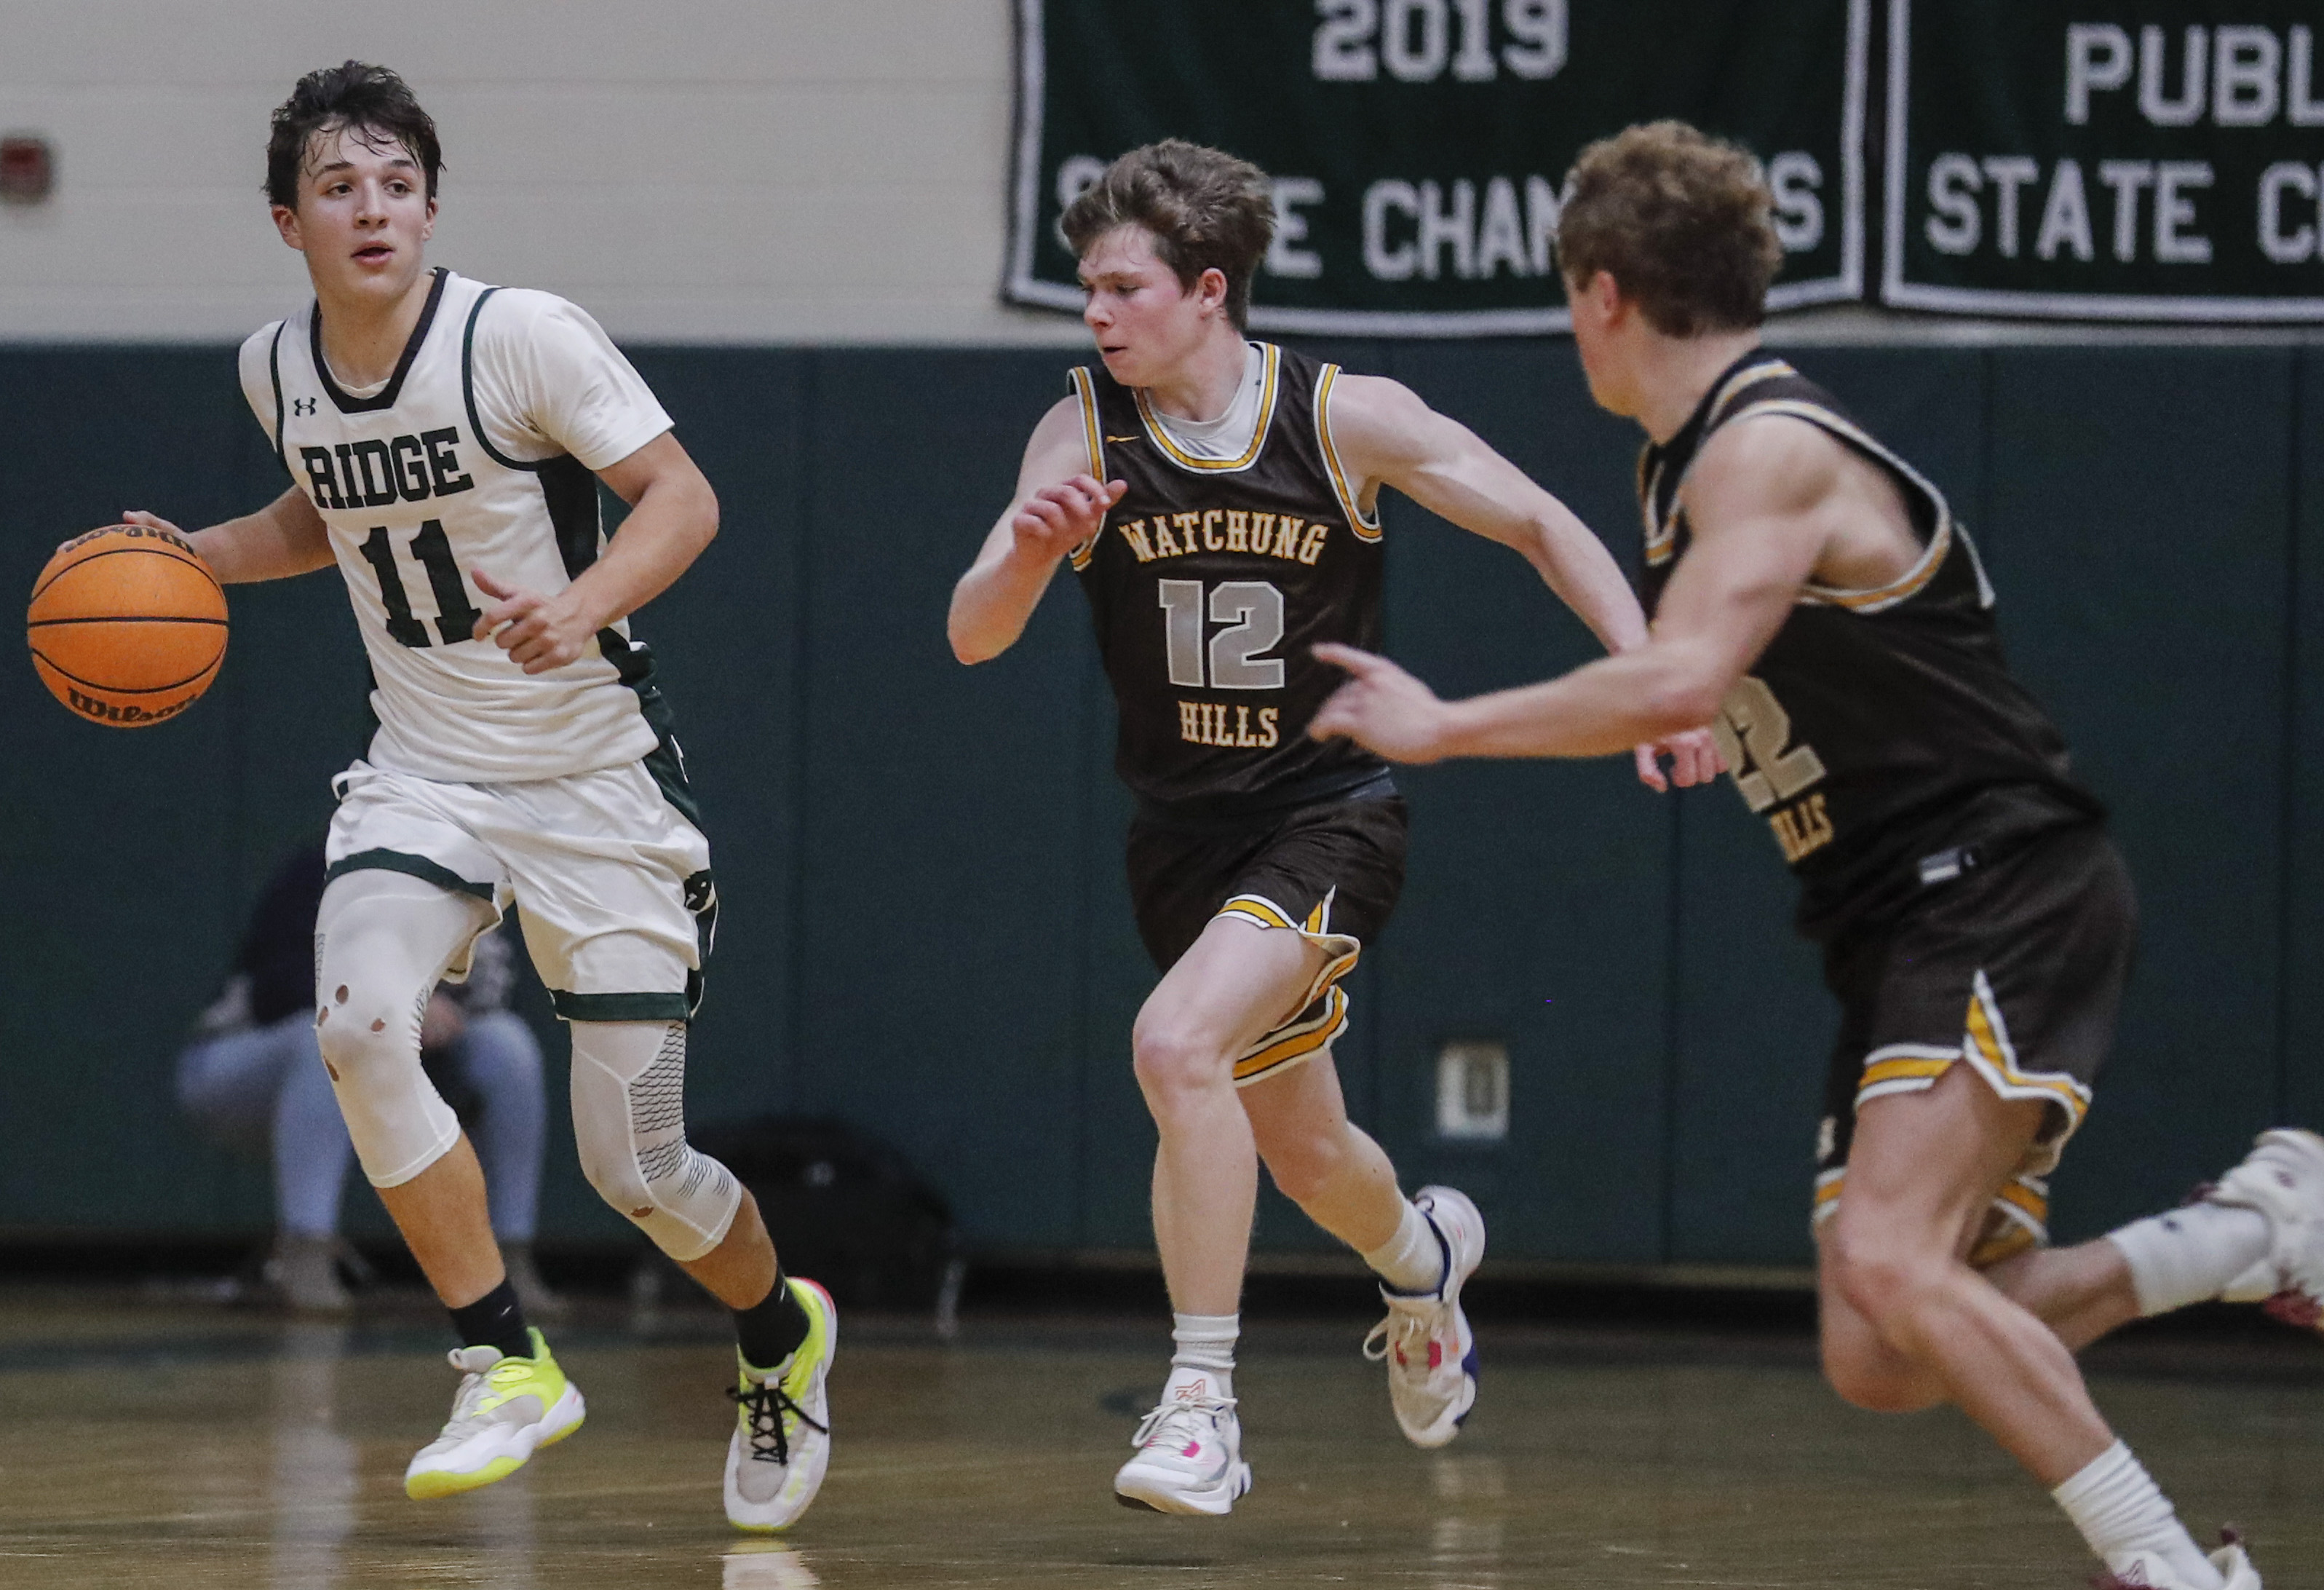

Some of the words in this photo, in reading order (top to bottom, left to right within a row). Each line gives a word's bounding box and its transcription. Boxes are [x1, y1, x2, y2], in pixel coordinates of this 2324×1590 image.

[1312, 0, 1568, 82] 2019
[1926, 153, 2214, 264] STATE
[300, 426, 475, 510] RIDGE
[1118, 510, 1329, 566] WATCHUNG
[359, 518, 483, 648] 11
[1159, 578, 1285, 689] 12
[68, 686, 197, 722] Wilson
[1178, 700, 1280, 748] HILLS
